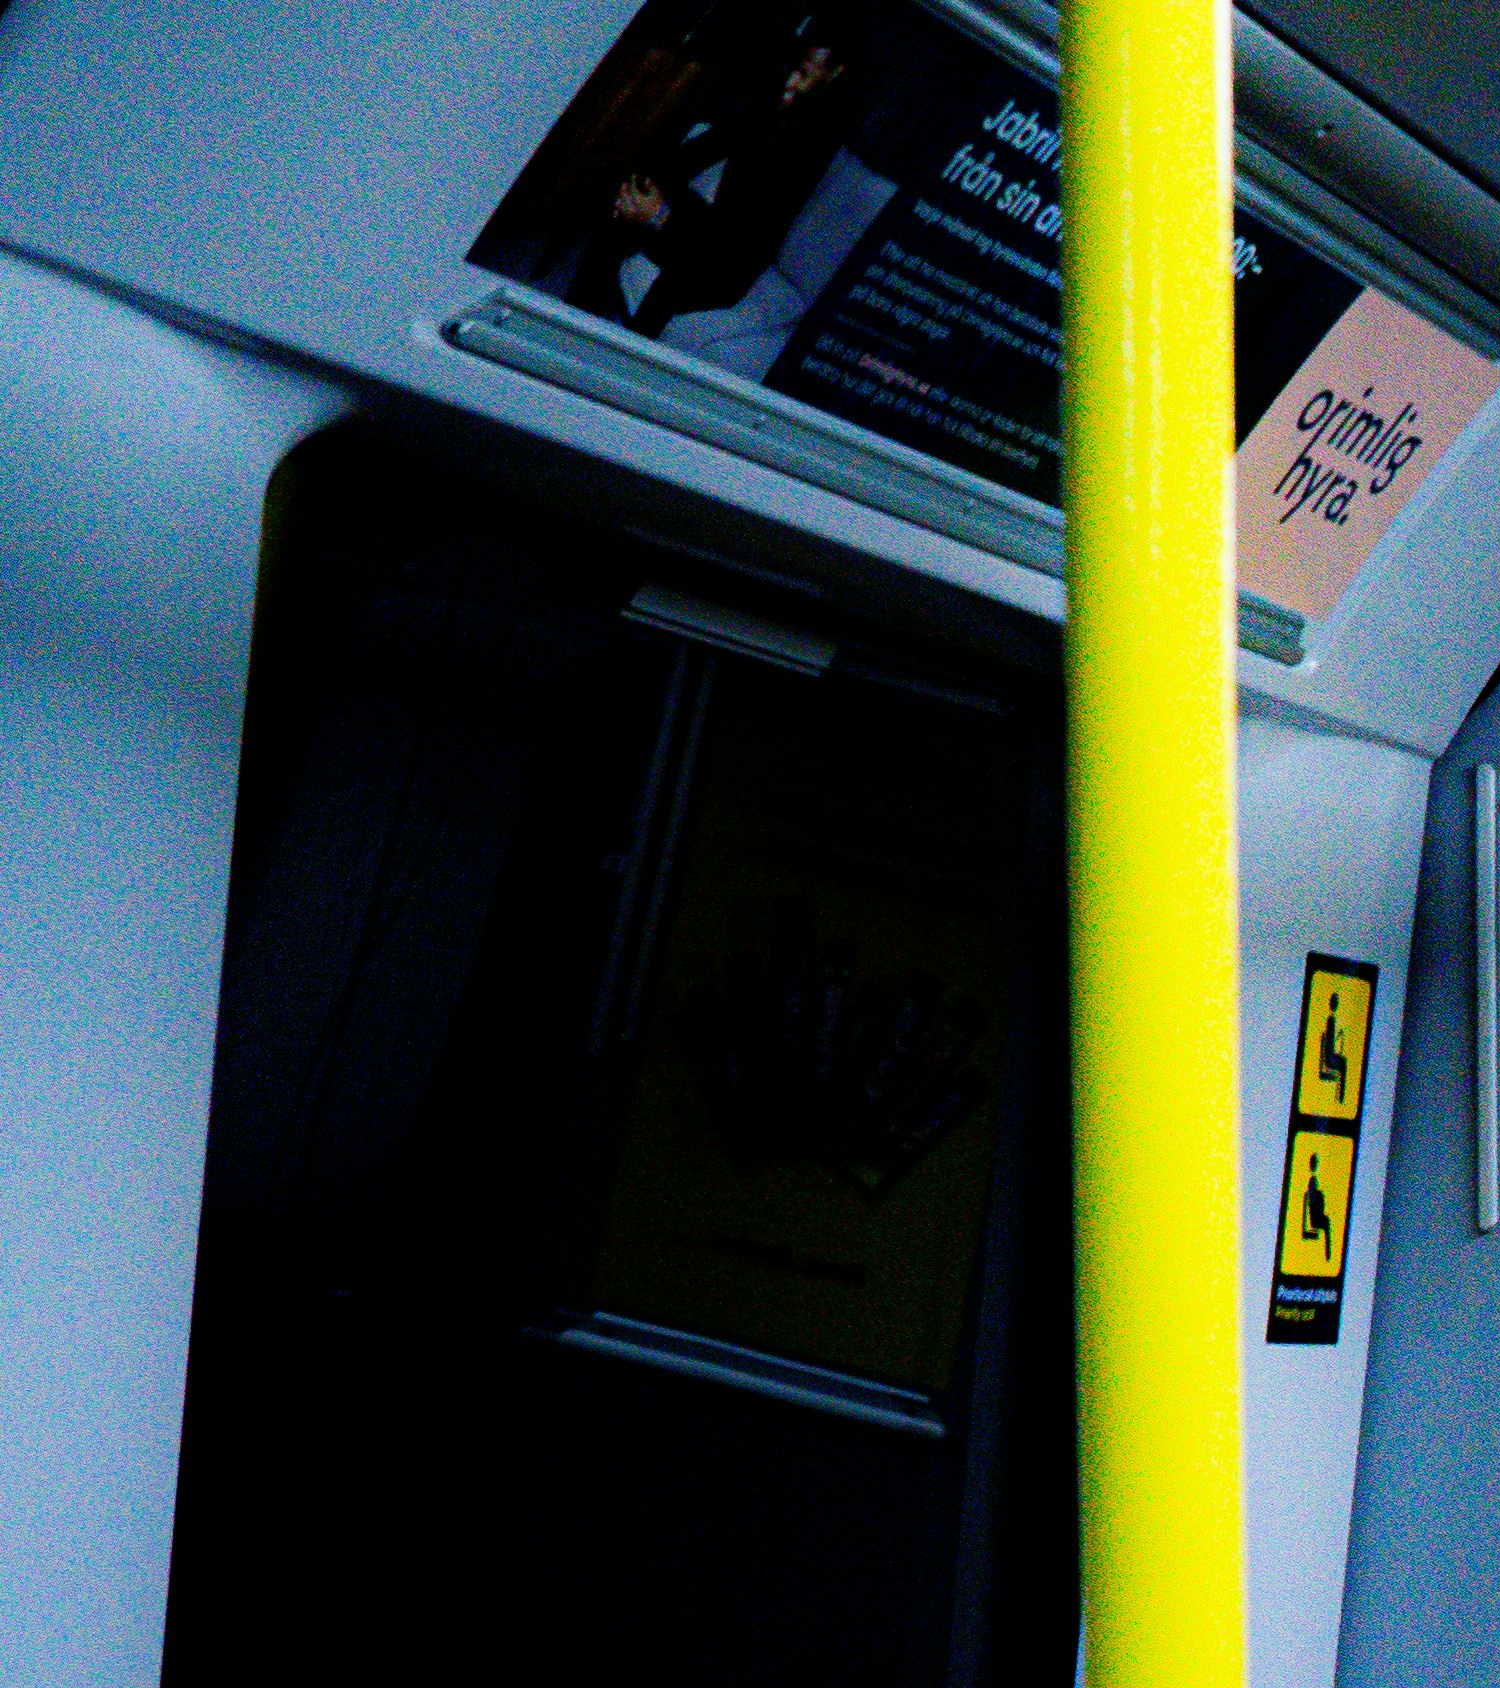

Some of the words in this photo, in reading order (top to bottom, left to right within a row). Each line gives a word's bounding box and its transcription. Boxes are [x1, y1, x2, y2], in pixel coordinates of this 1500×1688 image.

[941, 142, 1003, 201] från
[996, 179, 1042, 224] sin
[1297, 386, 1423, 494] orimlig
[1273, 451, 1358, 525] hyra.
